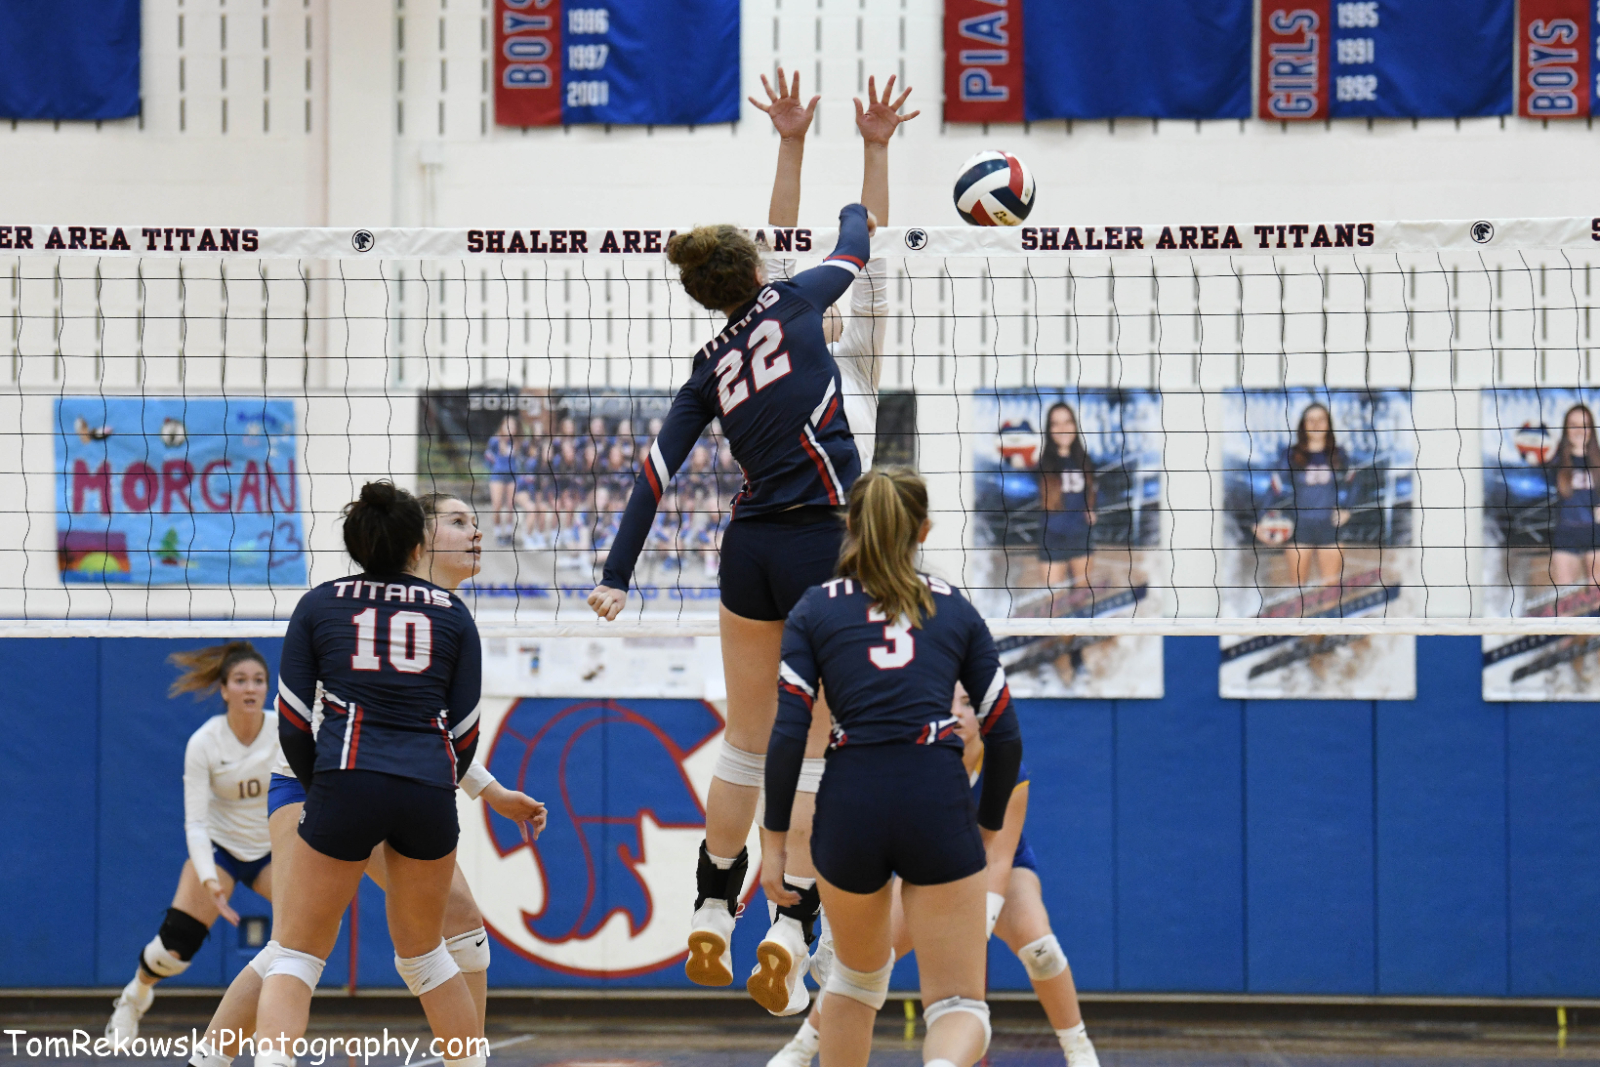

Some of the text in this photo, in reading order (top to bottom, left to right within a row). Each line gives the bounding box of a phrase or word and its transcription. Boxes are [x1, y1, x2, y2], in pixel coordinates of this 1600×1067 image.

[568, 44, 609, 71] 1997
[958, 0, 1009, 102] PIA
[1268, 8, 1320, 118] GIRLS
[1337, 37, 1375, 64] 1991
[1527, 18, 1579, 116] BOYS
[566, 80, 609, 107] 2001
[1336, 74, 1378, 101] 1992
[45, 226, 131, 250] AREA
[142, 227, 259, 252] TITANS
[467, 229, 588, 254] SHALER
[1021, 223, 1375, 251] SHALER AREA TITANS
[714, 318, 793, 417] 22
[72, 458, 297, 516] MORGAN
[258, 521, 304, 569] 23
[333, 580, 453, 608] TITANS
[350, 606, 434, 675] 10
[866, 601, 916, 671] 3
[238, 778, 262, 799] 10
